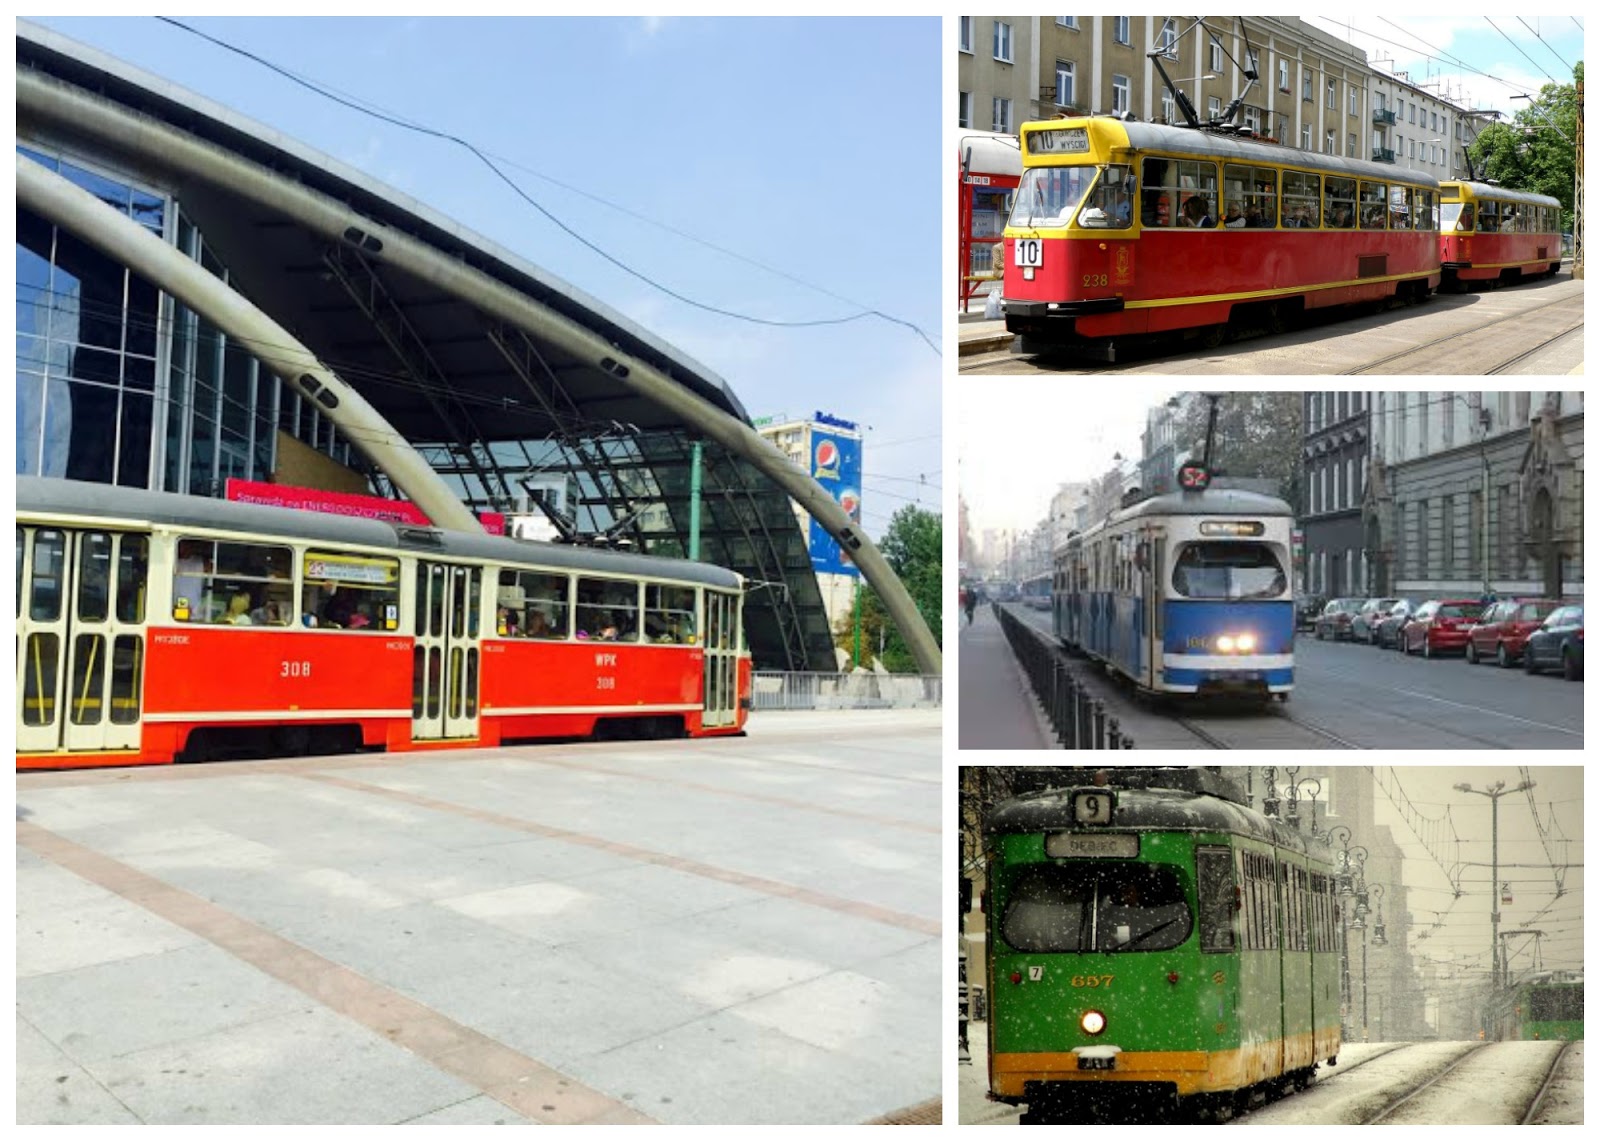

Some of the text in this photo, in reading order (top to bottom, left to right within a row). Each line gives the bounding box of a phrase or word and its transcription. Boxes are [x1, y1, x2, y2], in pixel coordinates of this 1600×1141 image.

[1019, 241, 1038, 264] 10
[1083, 274, 1108, 287] 238
[595, 653, 617, 667] WPK
[280, 660, 311, 678] 308
[1085, 796, 1100, 819] 9
[1071, 974, 1115, 988] 657
